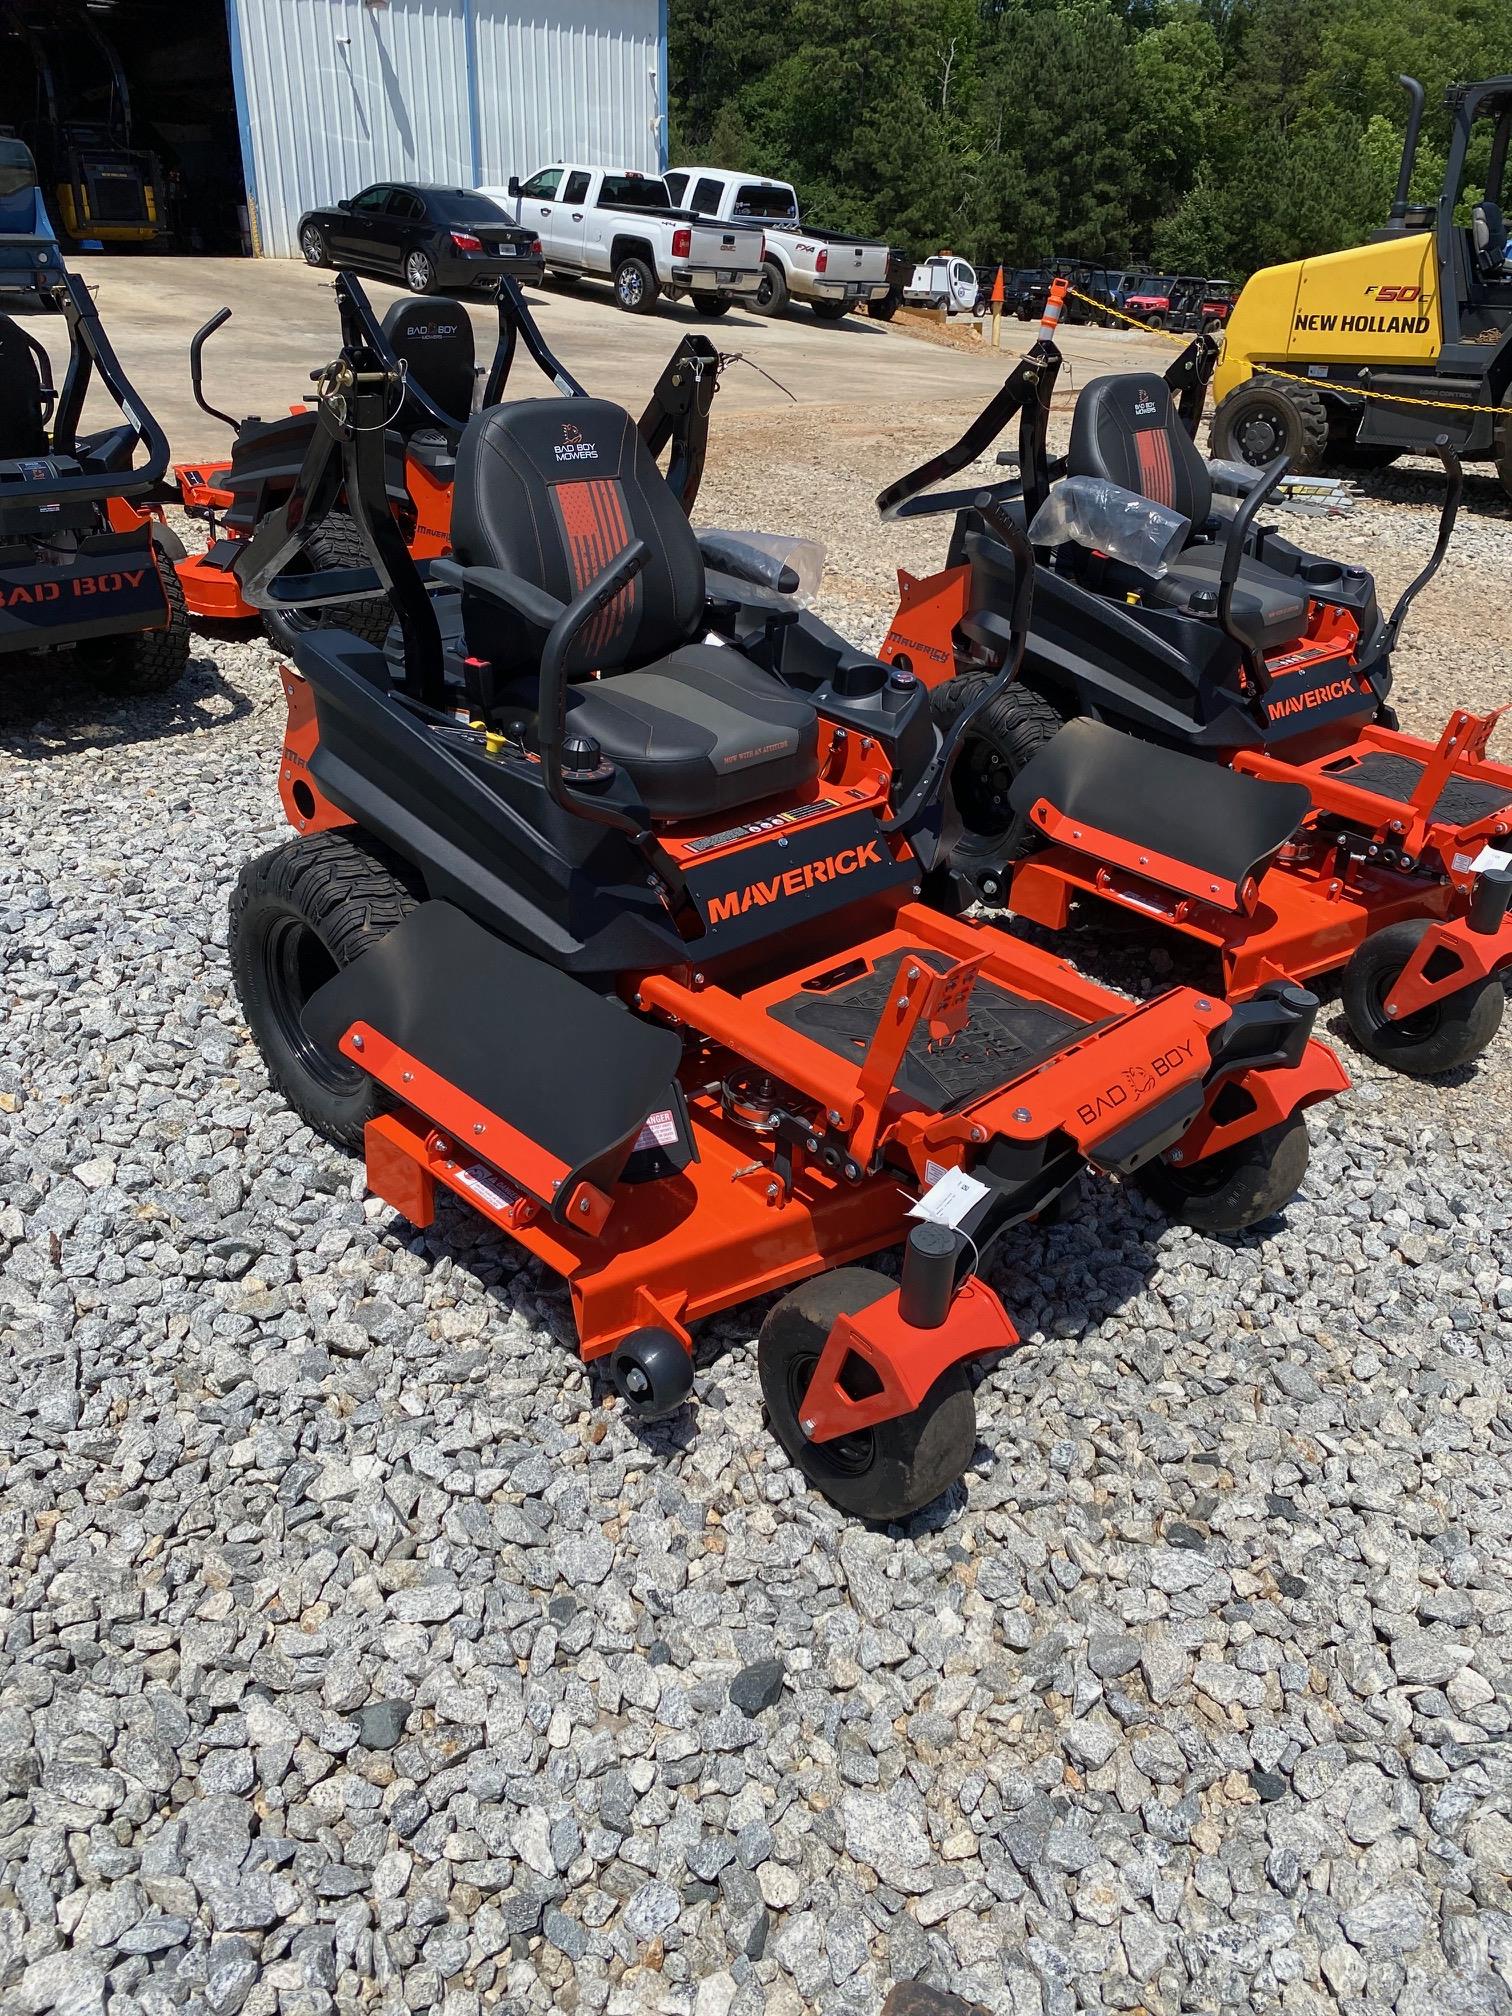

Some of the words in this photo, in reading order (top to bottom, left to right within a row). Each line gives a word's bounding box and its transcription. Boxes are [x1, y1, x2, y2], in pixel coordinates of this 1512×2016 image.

[407, 327, 428, 335] BAD
[438, 325, 457, 334] BOY
[1294, 315, 1338, 331] NEW
[1340, 316, 1431, 334] HOLLAND
[554, 444, 575, 454] BAD
[576, 443, 596, 452] BOY
[555, 450, 599, 462] MOWERS
[0, 586, 61, 609] AD
[72, 569, 145, 597] BOY
[1267, 678, 1356, 721] MAVERICK
[707, 839, 883, 925] MAVERICK
[1076, 1084, 1128, 1126] BAD
[1150, 1038, 1194, 1078] BOY
